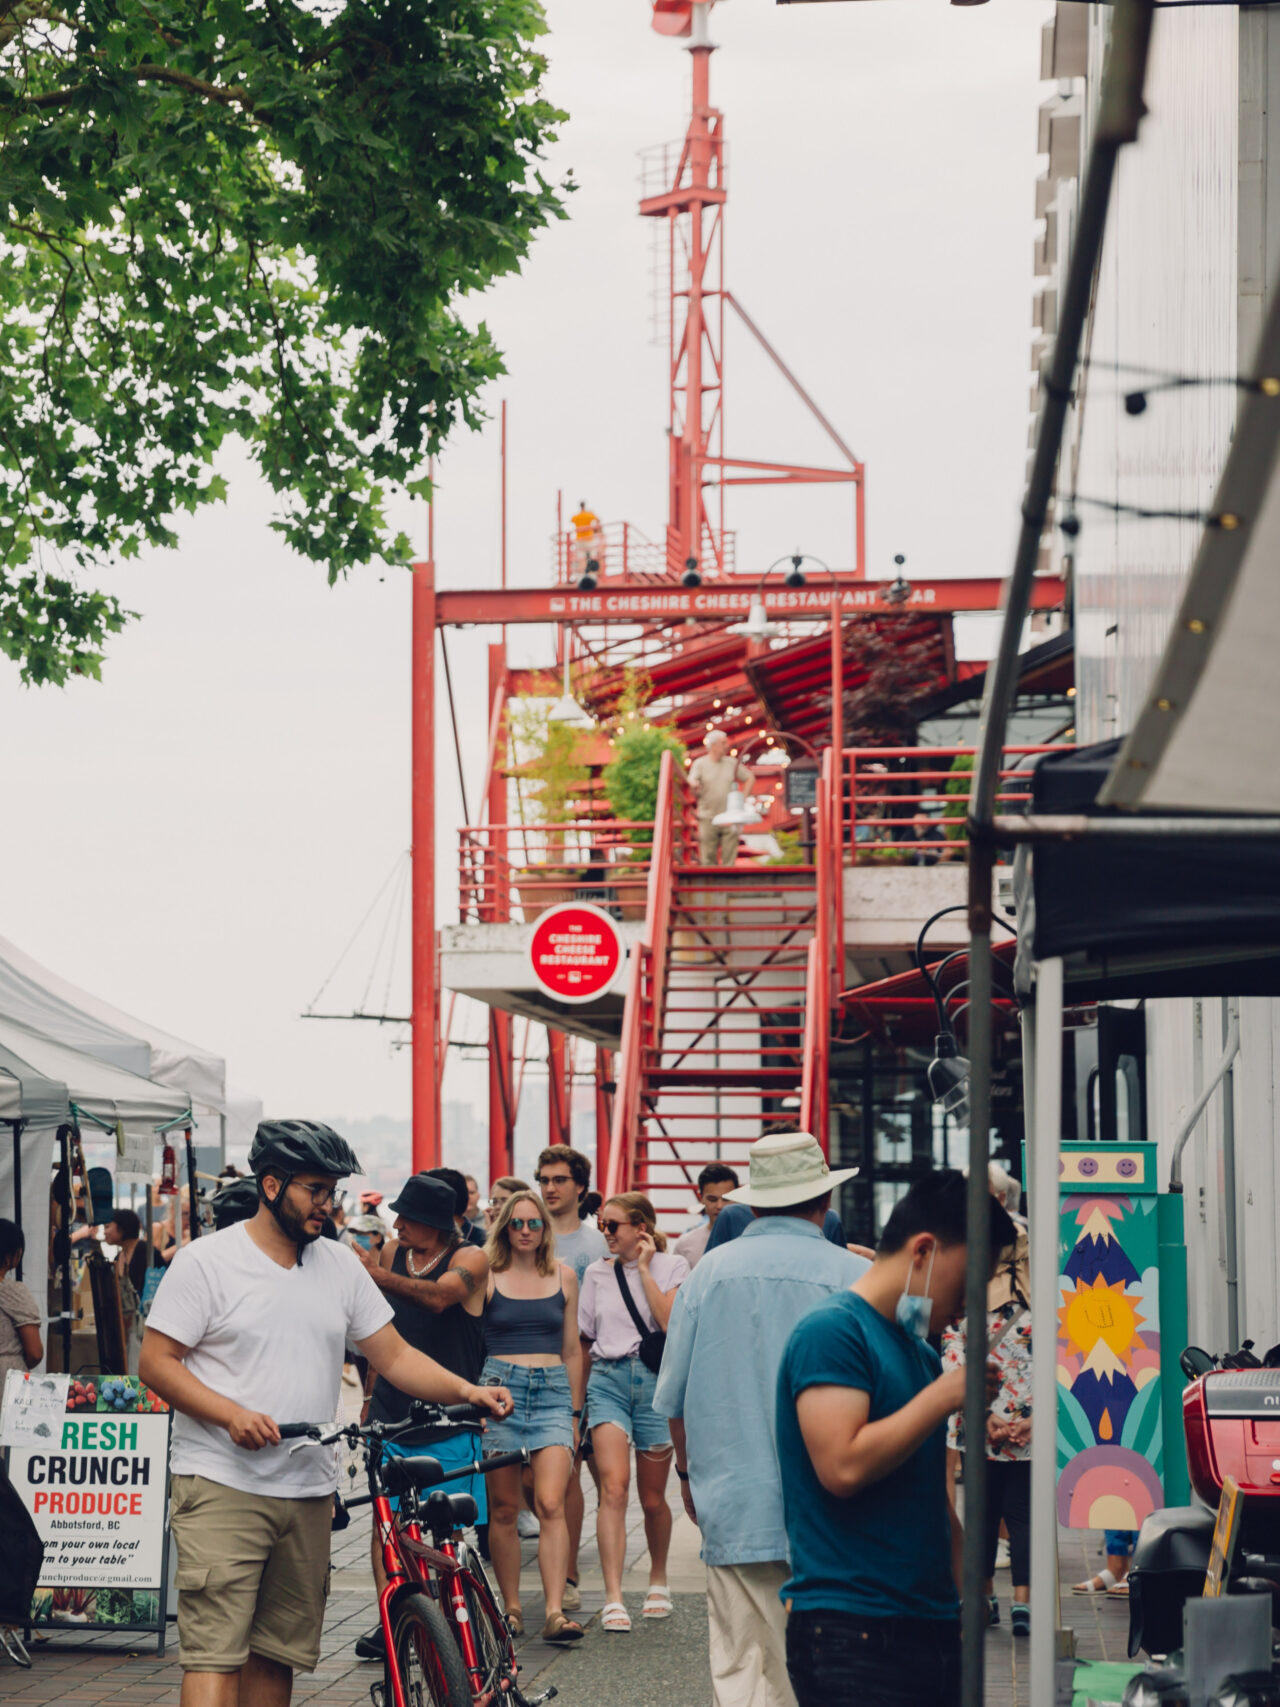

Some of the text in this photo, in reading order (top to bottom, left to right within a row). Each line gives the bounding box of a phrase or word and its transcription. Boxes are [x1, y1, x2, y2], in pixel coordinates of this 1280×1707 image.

[570, 596, 602, 612] THE
[606, 595, 690, 611] CHESHIRE
[548, 934, 602, 944] CHESHIRE
[554, 945, 596, 955] CHEESE
[540, 954, 609, 966] RESTAURANT
[27, 1455, 150, 1485] CRUNCH
[34, 1492, 142, 1515] PRODUCE
[51, 1520, 120, 1532] Abbotsford, BC
[60, 1541, 86, 1551] your
[88, 1541, 110, 1549] own
[113, 1540, 140, 1550] local
[58, 1554, 69, 1564] to
[71, 1556, 97, 1567] your
